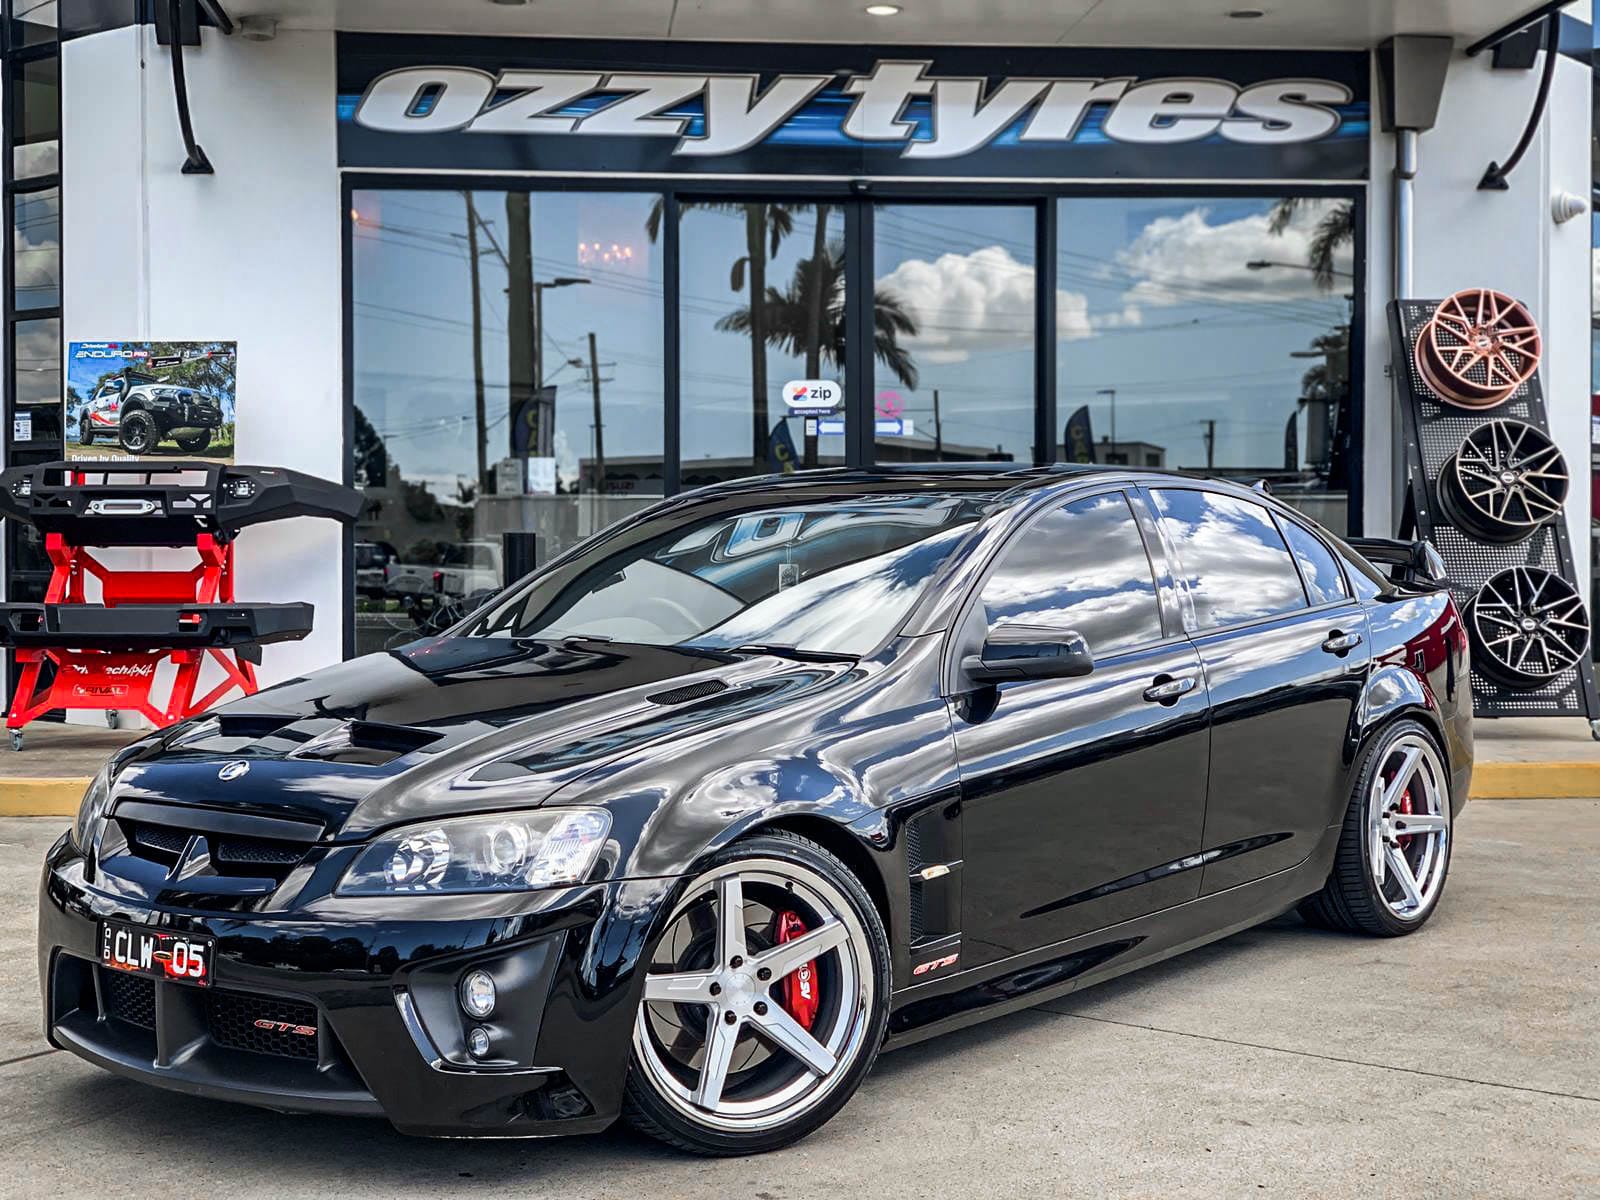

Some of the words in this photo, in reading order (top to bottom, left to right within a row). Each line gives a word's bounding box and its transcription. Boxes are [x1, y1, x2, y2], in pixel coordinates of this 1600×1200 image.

[353, 65, 836, 156] ozzy
[841, 58, 1352, 159] tyres
[811, 386, 832, 400] zip
[103, 927, 112, 960] QLD
[115, 930, 154, 969] CLW
[172, 941, 205, 978] 05
[254, 1018, 318, 1036] GTS
